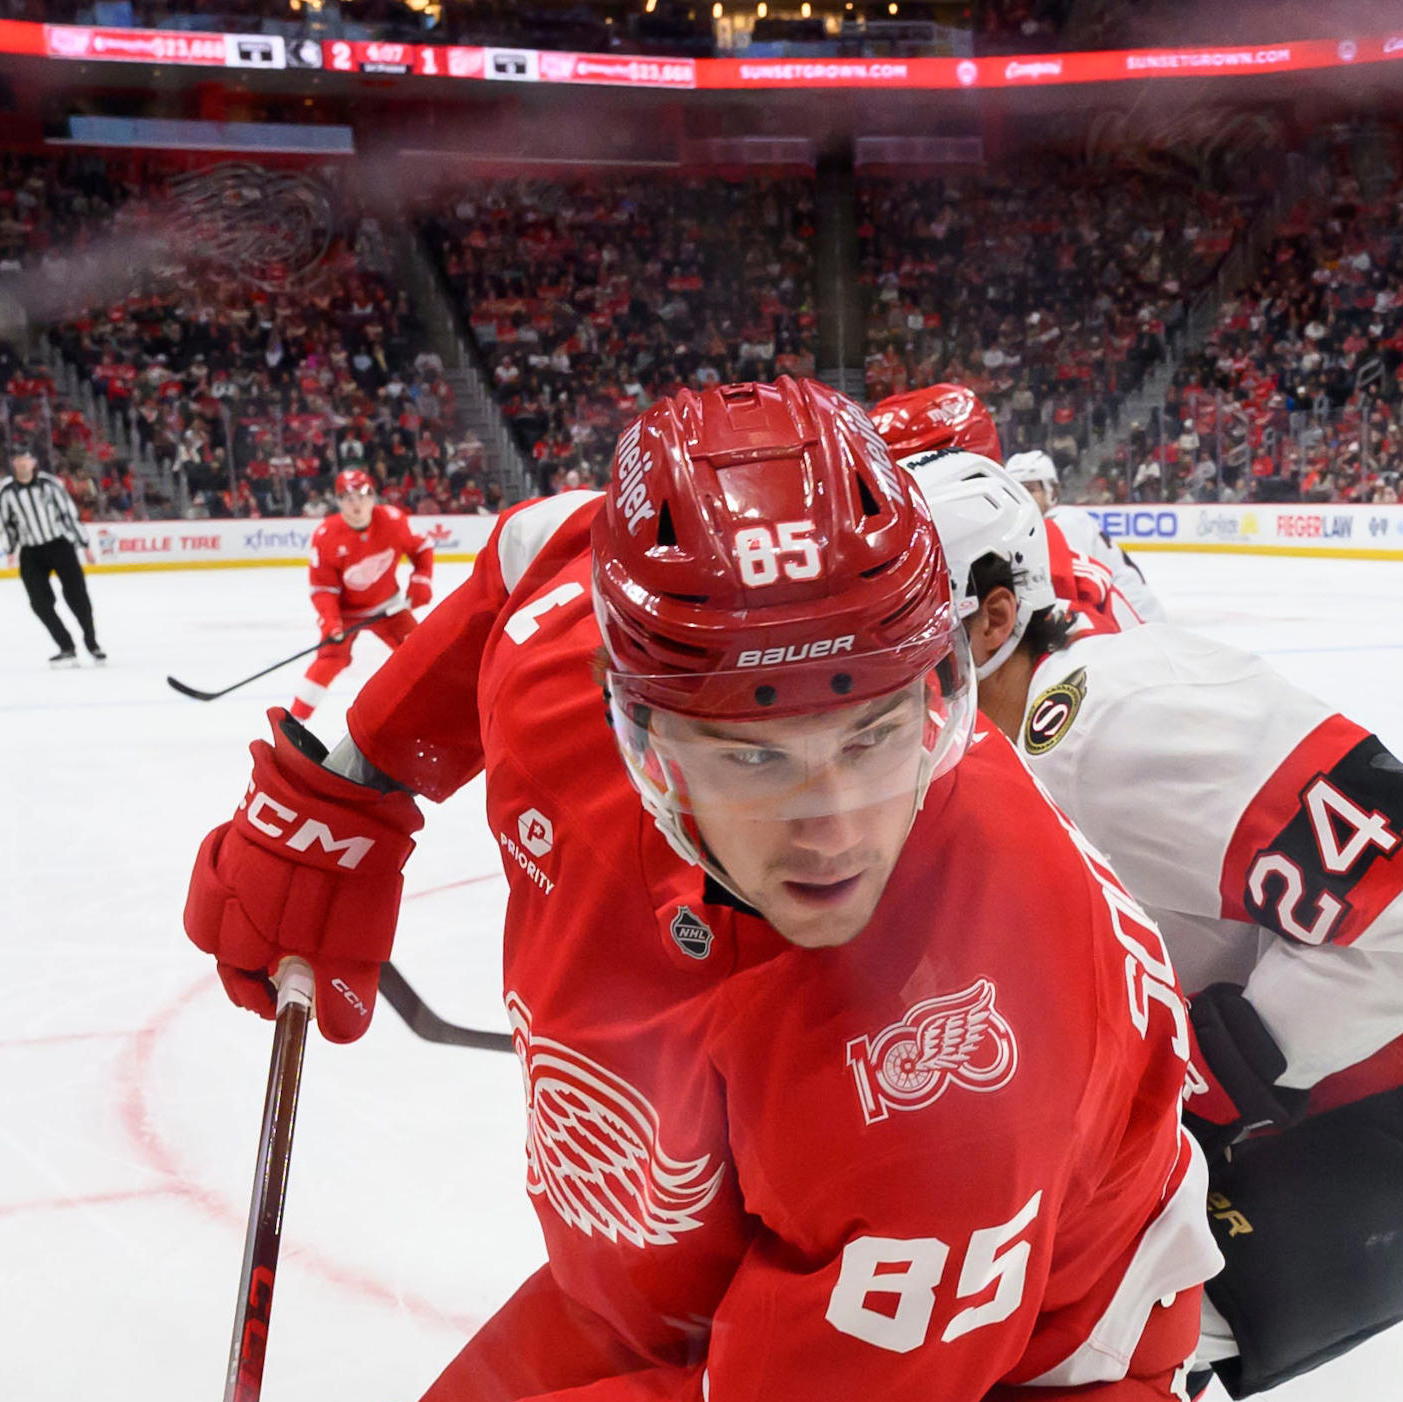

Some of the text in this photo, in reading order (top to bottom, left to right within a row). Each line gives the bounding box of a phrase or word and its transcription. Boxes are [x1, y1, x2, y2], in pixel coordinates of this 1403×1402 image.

[331, 42, 352, 70] 2
[421, 47, 438, 74] 1
[740, 64, 907, 80] SUNSETGROWN.COM
[1126, 50, 1290, 70] SUNSETGROWN.COM
[618, 420, 656, 536] meijer
[244, 528, 312, 551] xfinity
[1086, 511, 1177, 538] EICO
[119, 534, 221, 552] BELLE TIRE
[734, 519, 823, 588] 85
[736, 634, 856, 668] BAUER
[500, 832, 556, 896] PRIORITY
[1248, 774, 1403, 946] 24
[678, 928, 706, 940] NHL
[331, 977, 368, 1017] CCM
[825, 1189, 1043, 1355] 85
